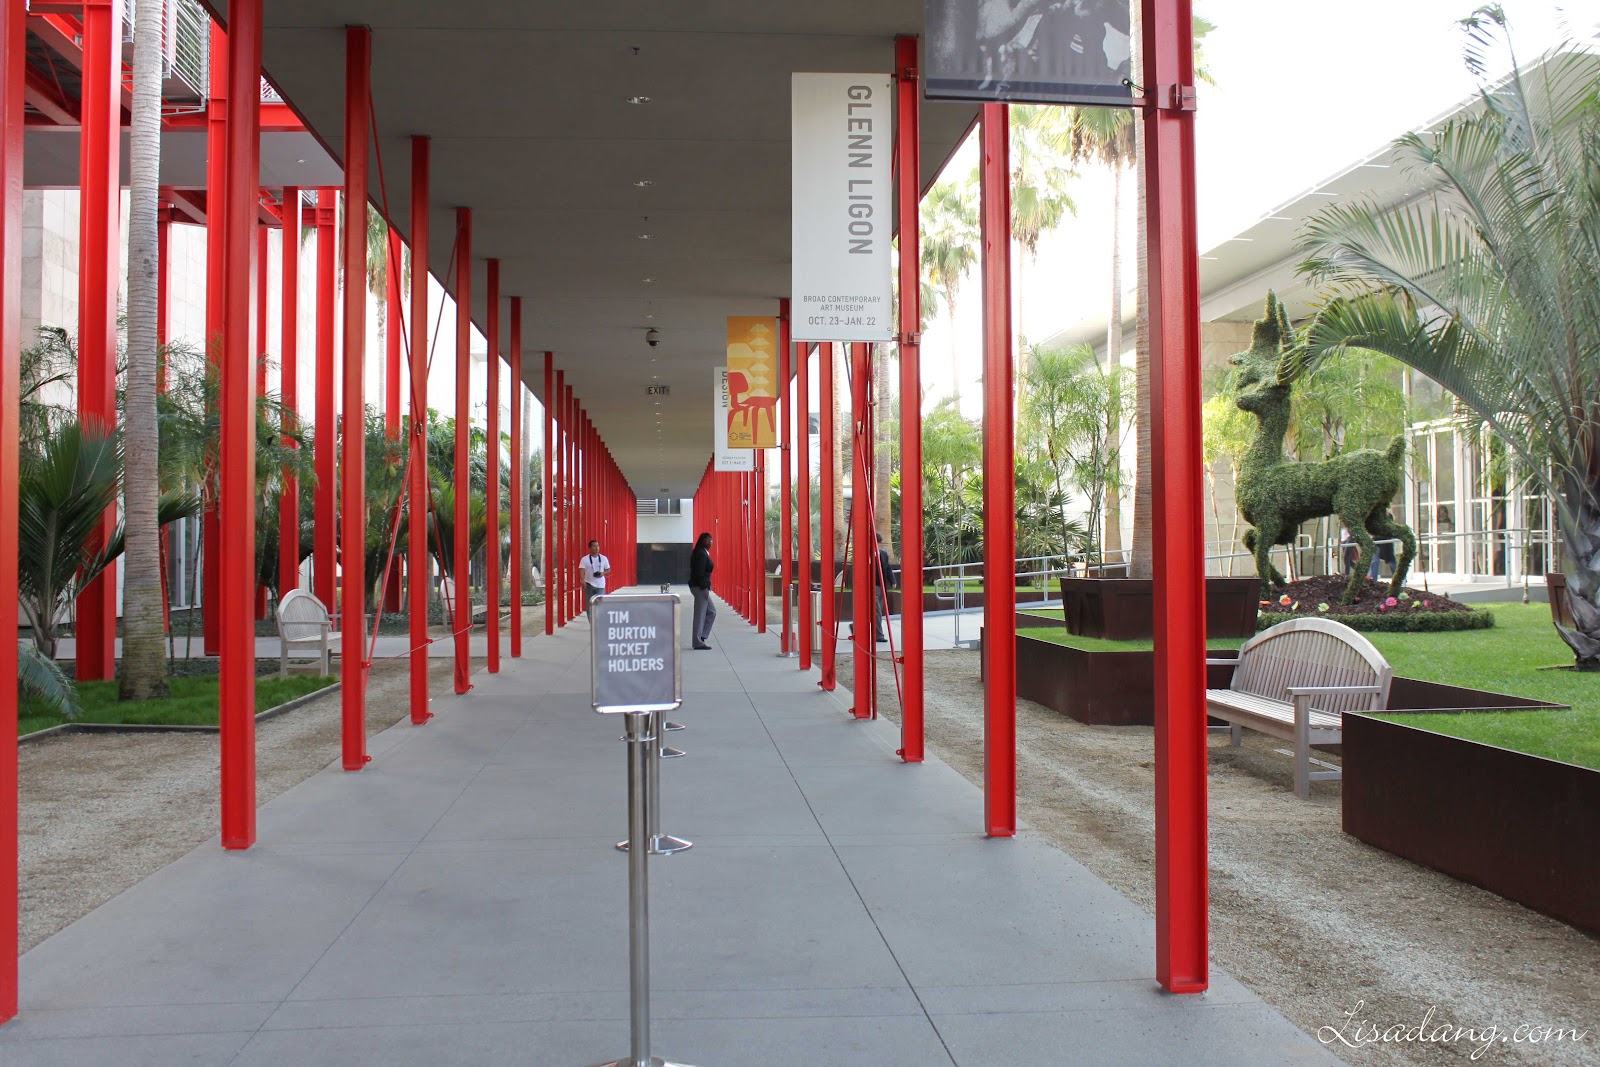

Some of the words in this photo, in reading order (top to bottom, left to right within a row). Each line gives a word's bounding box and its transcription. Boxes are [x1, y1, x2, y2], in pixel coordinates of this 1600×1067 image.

[847, 85, 873, 168] GLENN
[848, 179, 874, 254] LIGON
[803, 295, 826, 303] BROAD
[827, 295, 881, 303] CONTEMPORARY
[808, 316, 827, 325] OCT.
[866, 316, 876, 326] 22
[648, 386, 666, 395] EXIT
[607, 611, 630, 624] TIM
[608, 626, 656, 640] BURTON
[607, 643, 650, 656] TICKET
[608, 658, 664, 672] HOLDERS
